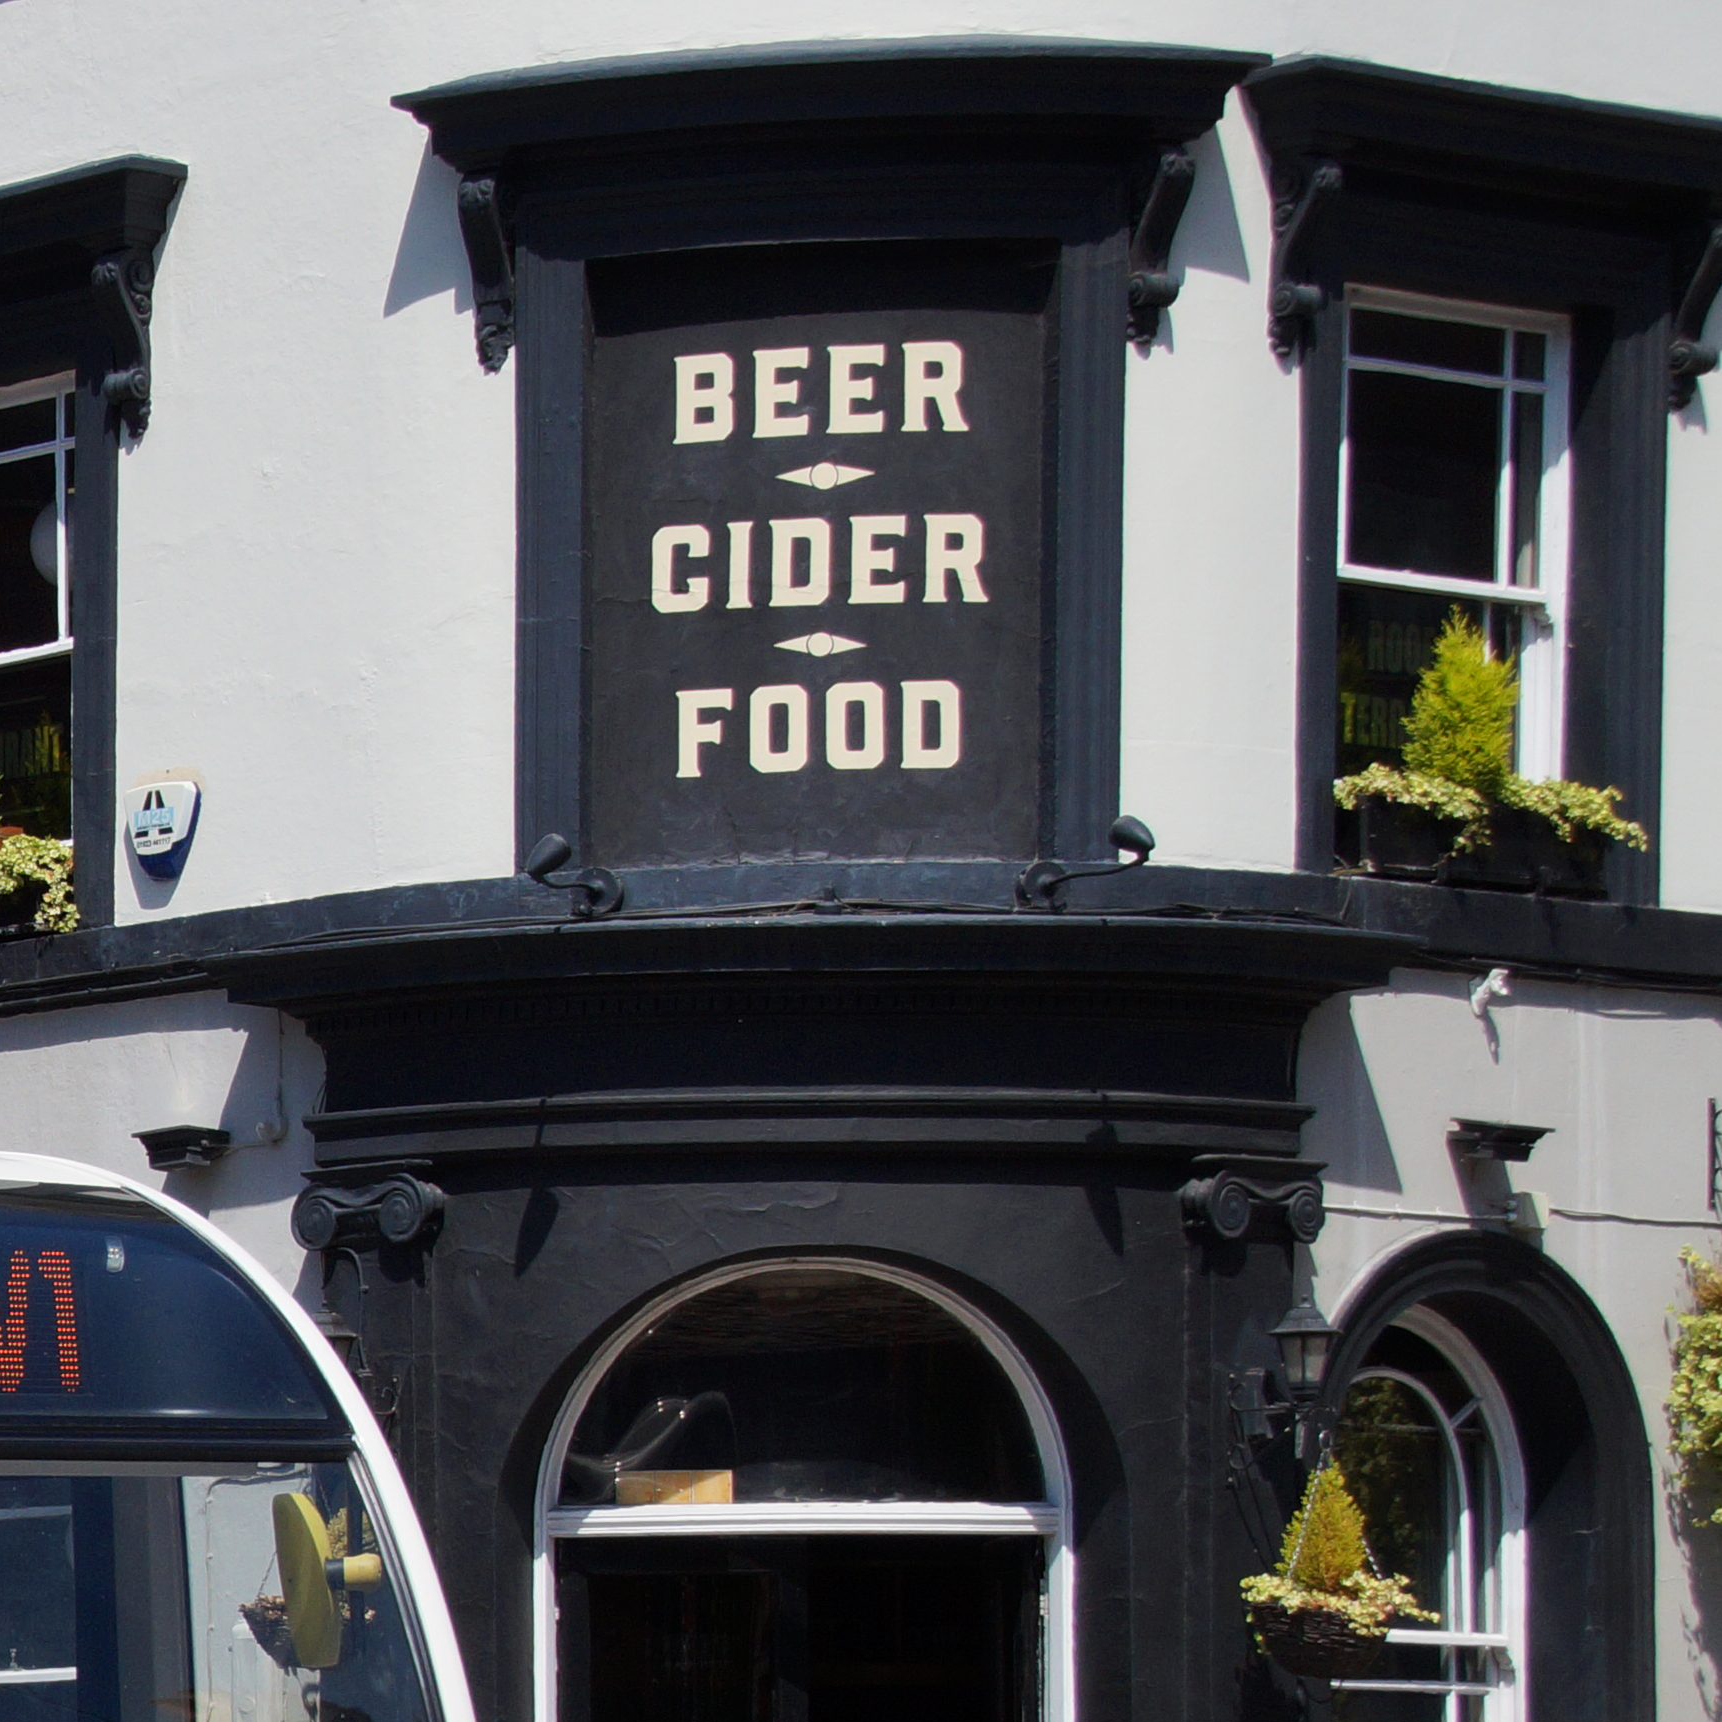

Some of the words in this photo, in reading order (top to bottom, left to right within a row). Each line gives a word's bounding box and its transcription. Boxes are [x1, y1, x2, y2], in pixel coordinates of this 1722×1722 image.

[672, 340, 970, 445] BEER
[651, 512, 989, 614] CIDER
[675, 679, 961, 779] FOOD
[137, 808, 171, 827] M25
